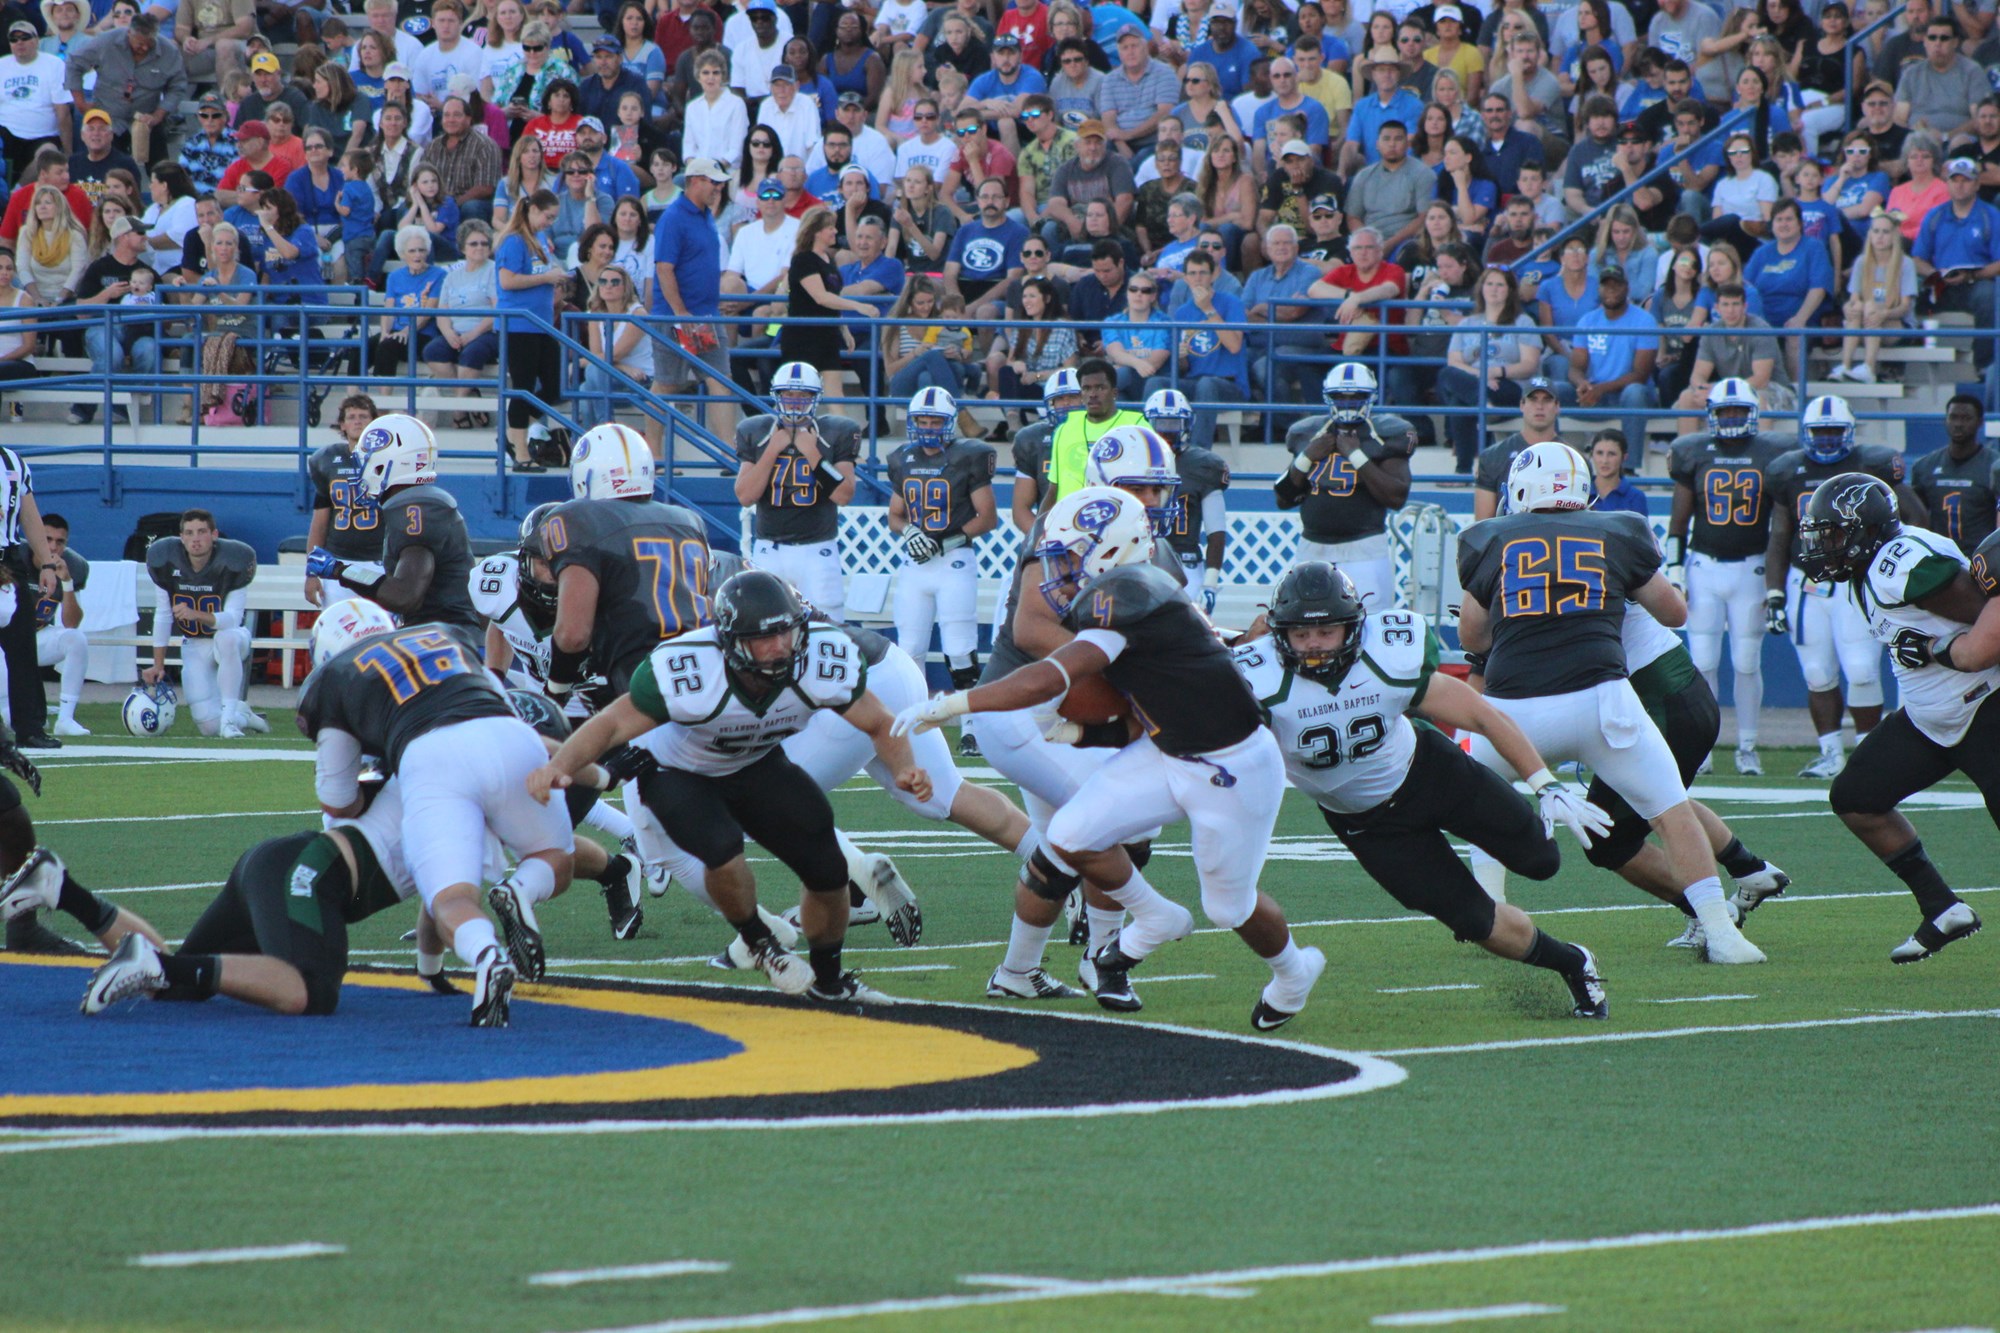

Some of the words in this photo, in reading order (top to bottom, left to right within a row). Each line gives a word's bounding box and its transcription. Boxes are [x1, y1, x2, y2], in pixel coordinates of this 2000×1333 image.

[535, 129, 577, 141] THE
[771, 455, 818, 507] 79
[1308, 452, 1357, 497] 75
[1704, 468, 1762, 526] 63
[330, 479, 379, 530] 95
[406, 504, 422, 535] 3
[902, 477, 950, 531] 89
[1942, 491, 1963, 540] 1
[540, 515, 568, 561] 70
[1877, 542, 1912, 579] 92
[480, 561, 509, 596] 39
[632, 537, 712, 638] 70
[1500, 536, 1606, 619] 65
[1093, 590, 1113, 627] 4
[1380, 613, 1415, 647] 32
[509, 634, 540, 654] OKLAHOMA
[817, 640, 849, 683] 52
[353, 630, 472, 706] 16
[666, 652, 704, 698] 52
[719, 723, 761, 734] OKLAHOMA
[764, 714, 799, 729] BAPTIST
[1297, 703, 1341, 720] OKLAHOMA
[1343, 693, 1381, 710] BAPTIST
[1297, 711, 1388, 771] 32
